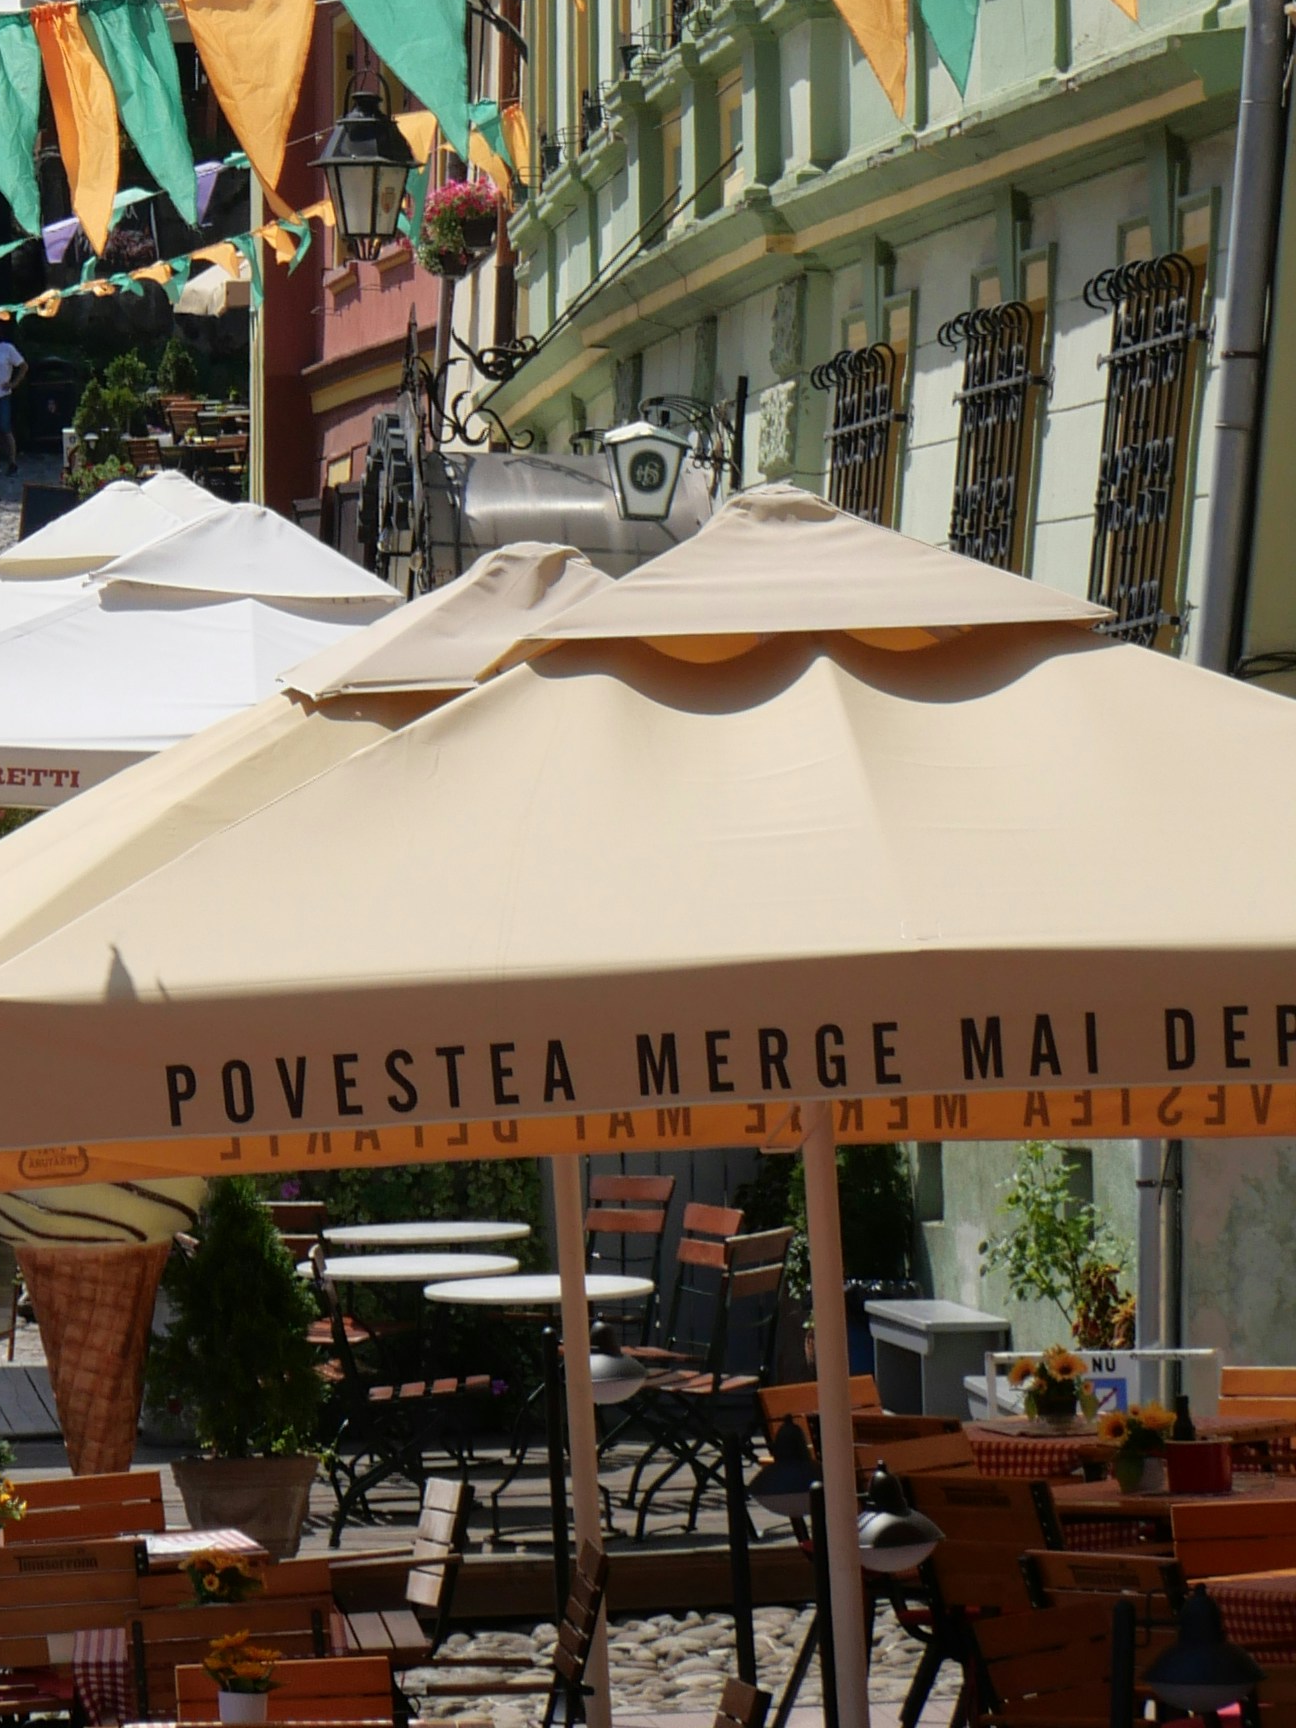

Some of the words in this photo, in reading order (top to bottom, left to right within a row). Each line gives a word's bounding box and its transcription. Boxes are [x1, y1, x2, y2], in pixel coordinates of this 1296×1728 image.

[164, 1039, 576, 1127] POVESTEA
[635, 1021, 903, 1098] MERGE
[960, 1011, 1100, 1081] MAI
[1092, 1356, 1117, 1372] NU
